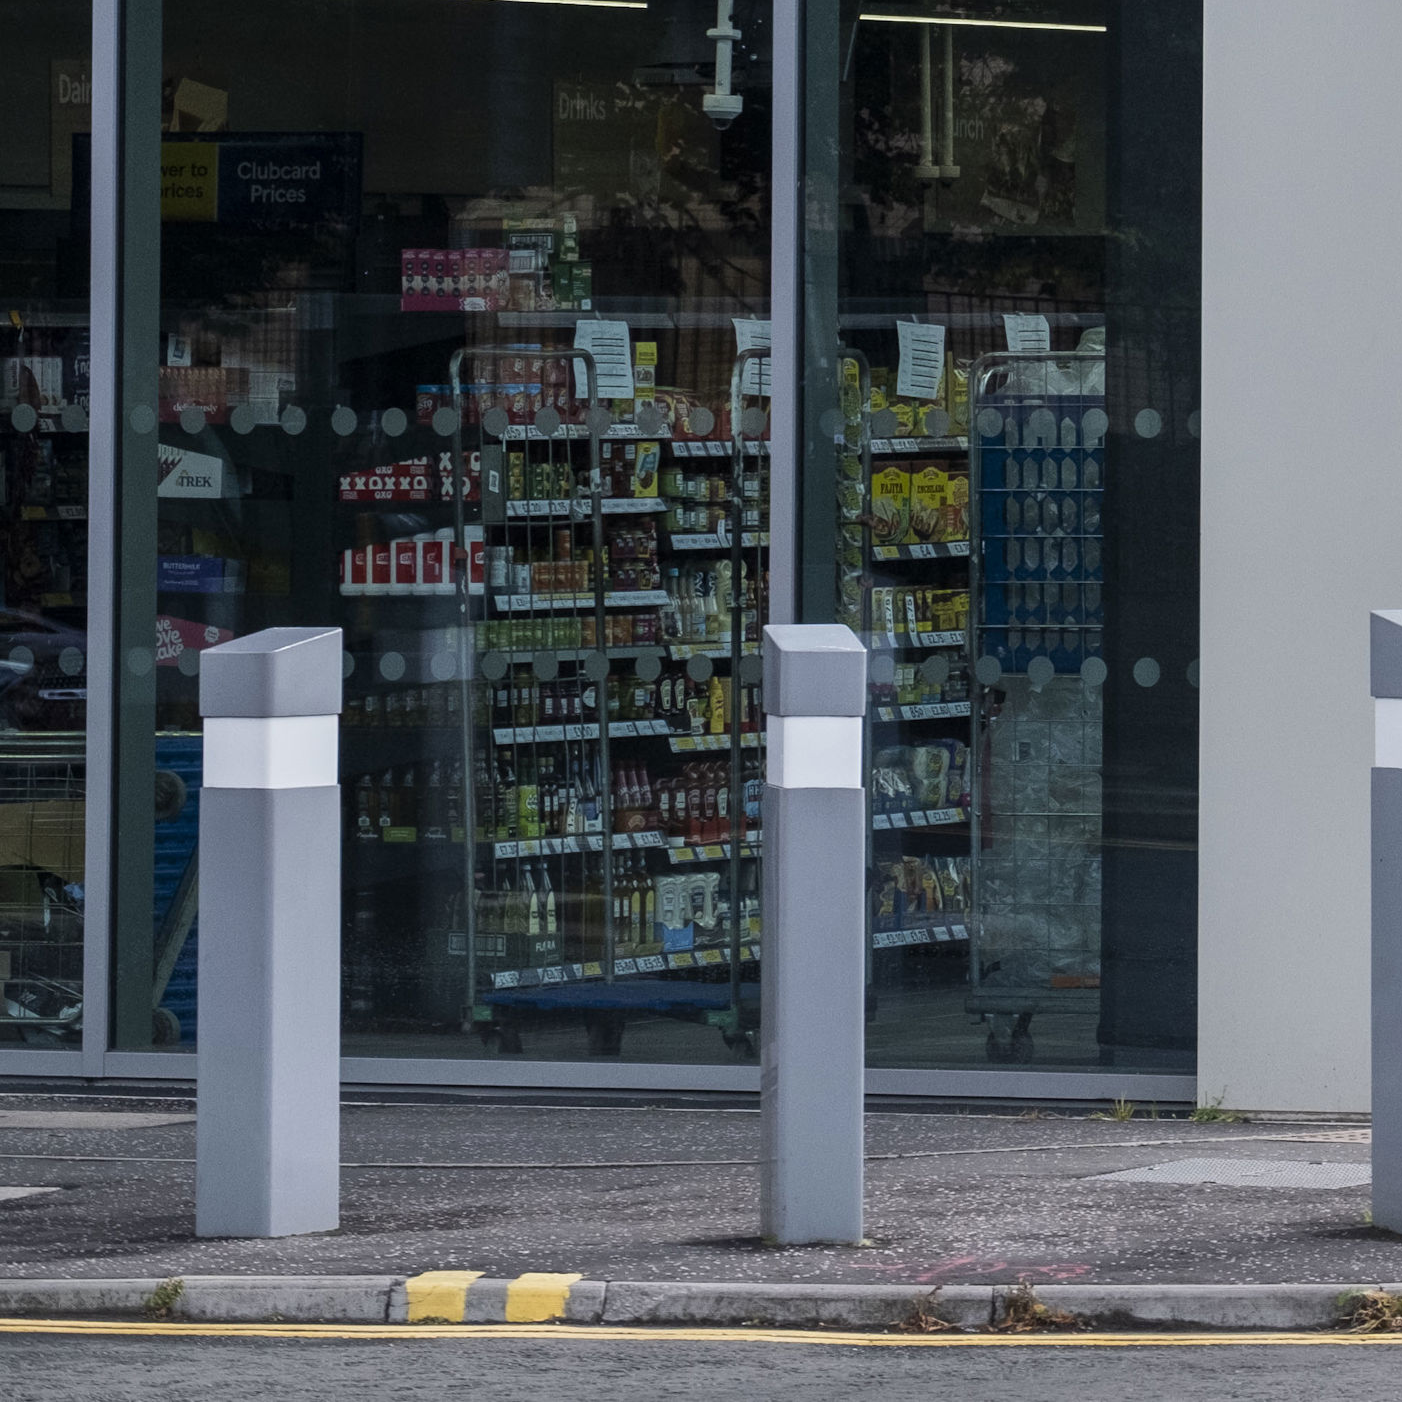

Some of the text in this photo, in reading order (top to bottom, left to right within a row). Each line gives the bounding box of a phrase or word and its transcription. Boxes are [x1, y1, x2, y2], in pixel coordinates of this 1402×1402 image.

[58, 73, 92, 105] Dair
[558, 91, 607, 120] Drinks
[953, 114, 985, 140] unch
[190, 163, 208, 178] to
[236, 160, 321, 180] Clubcard
[160, 184, 204, 199] rices
[249, 184, 307, 203] Prices
[178, 475, 213, 488] TREK
